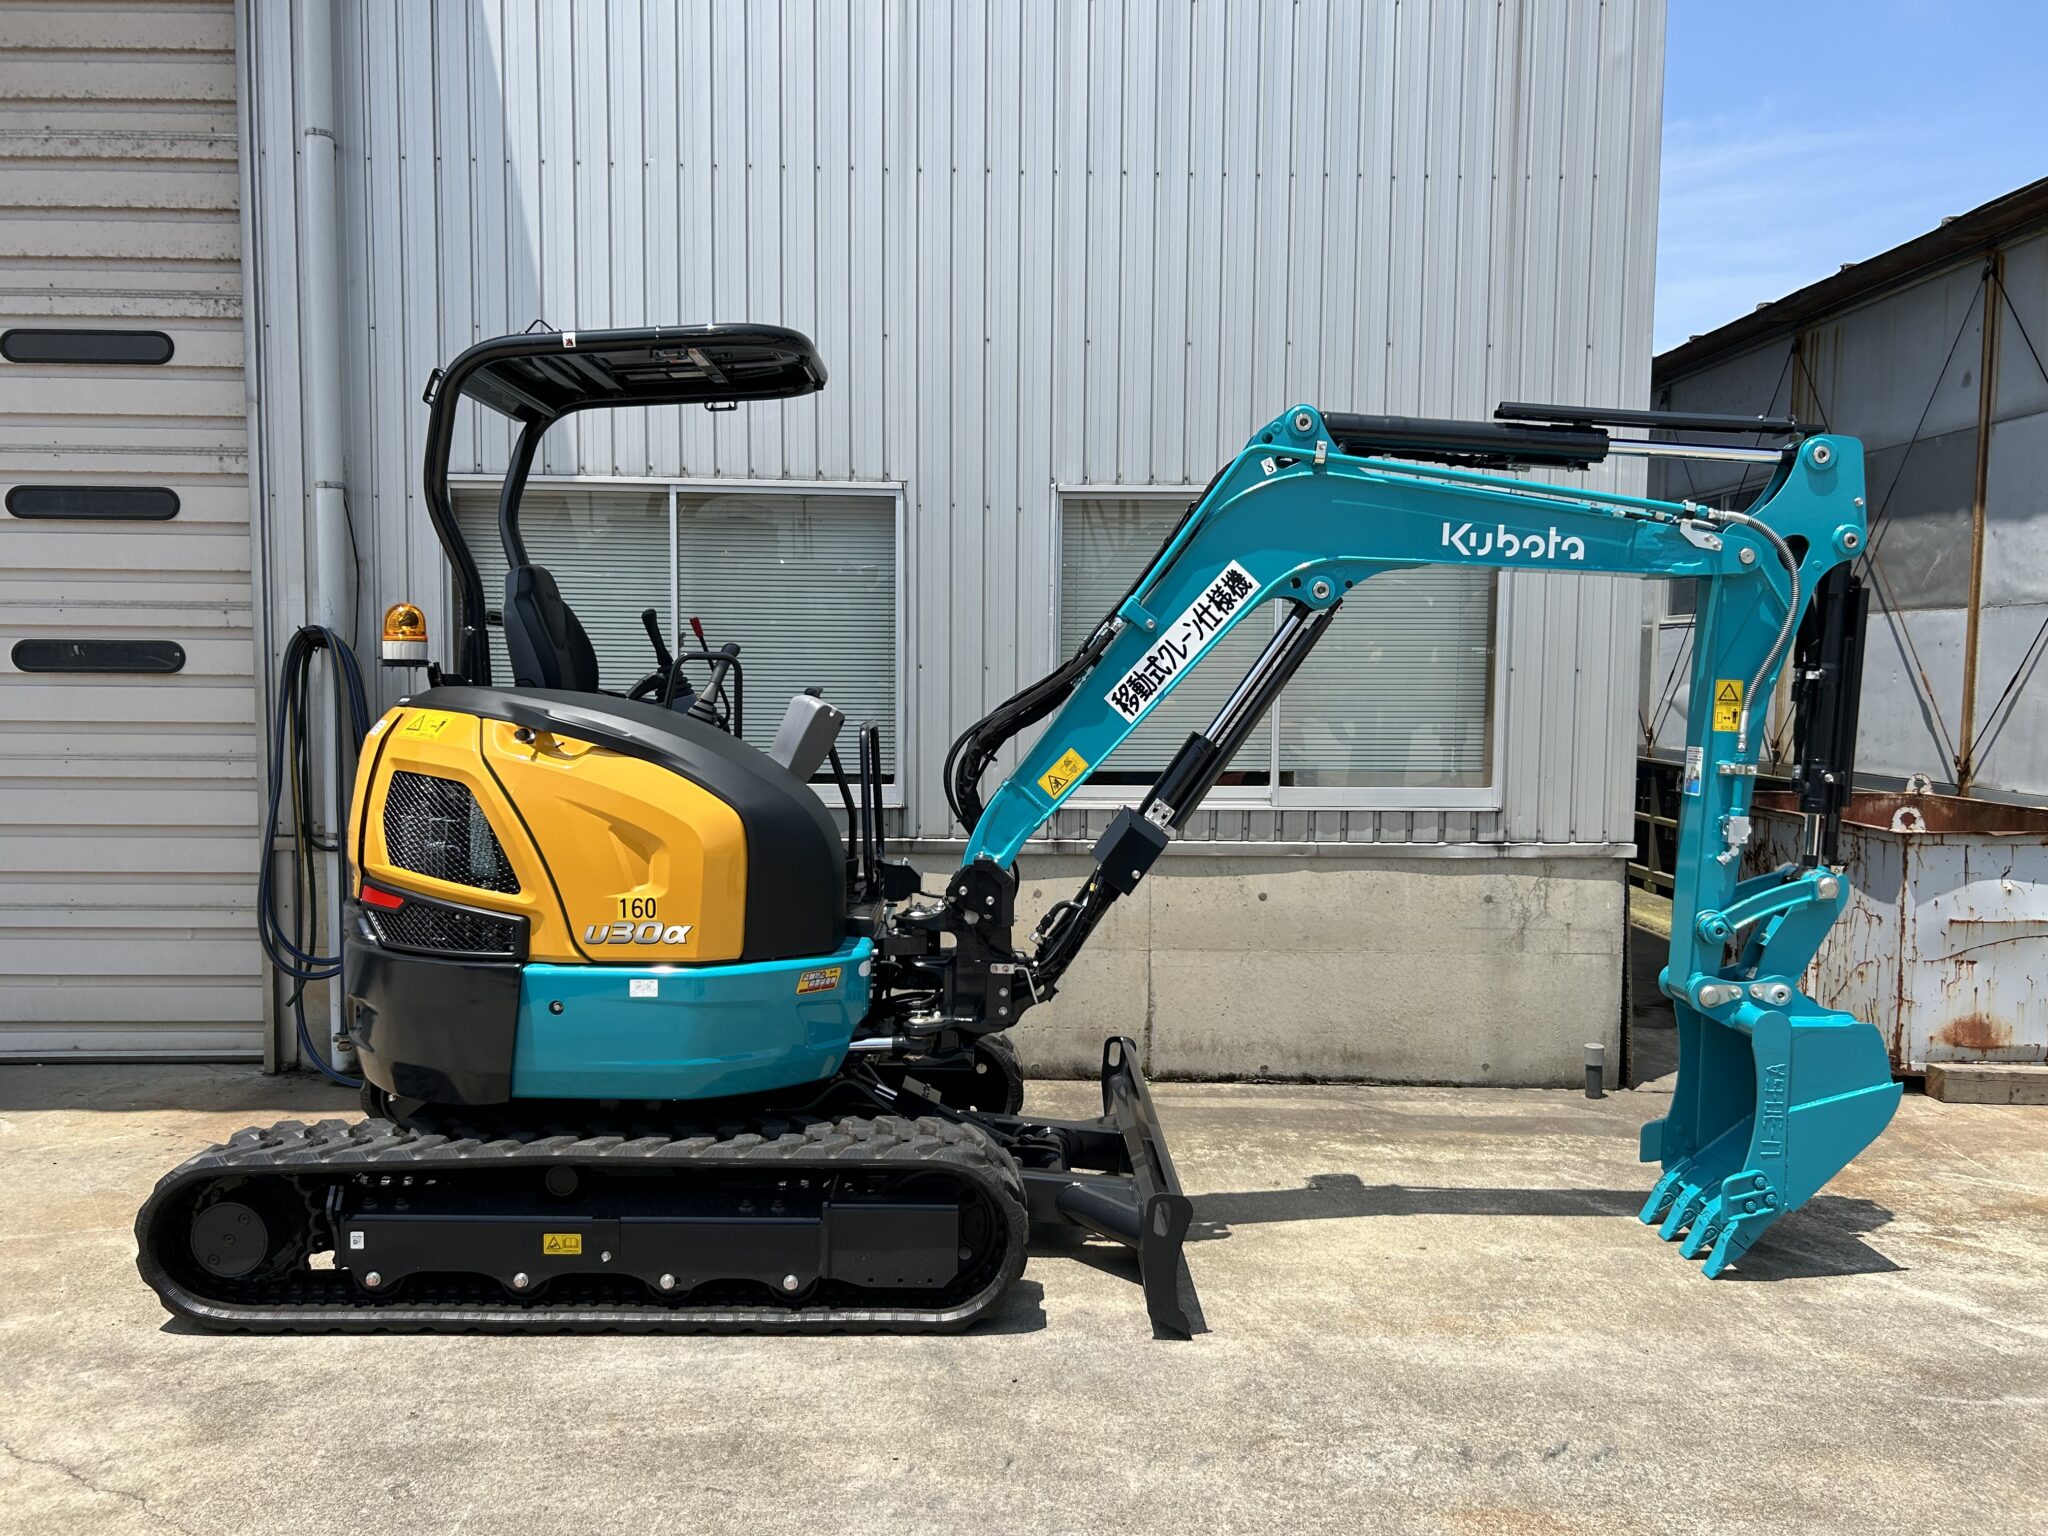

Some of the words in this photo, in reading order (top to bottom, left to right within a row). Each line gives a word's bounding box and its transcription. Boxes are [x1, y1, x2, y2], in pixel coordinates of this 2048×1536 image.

[1442, 522, 1585, 560] Kubota
[1111, 569, 1253, 716] 移動式クレーン仕様機
[619, 897, 656, 918] 160
